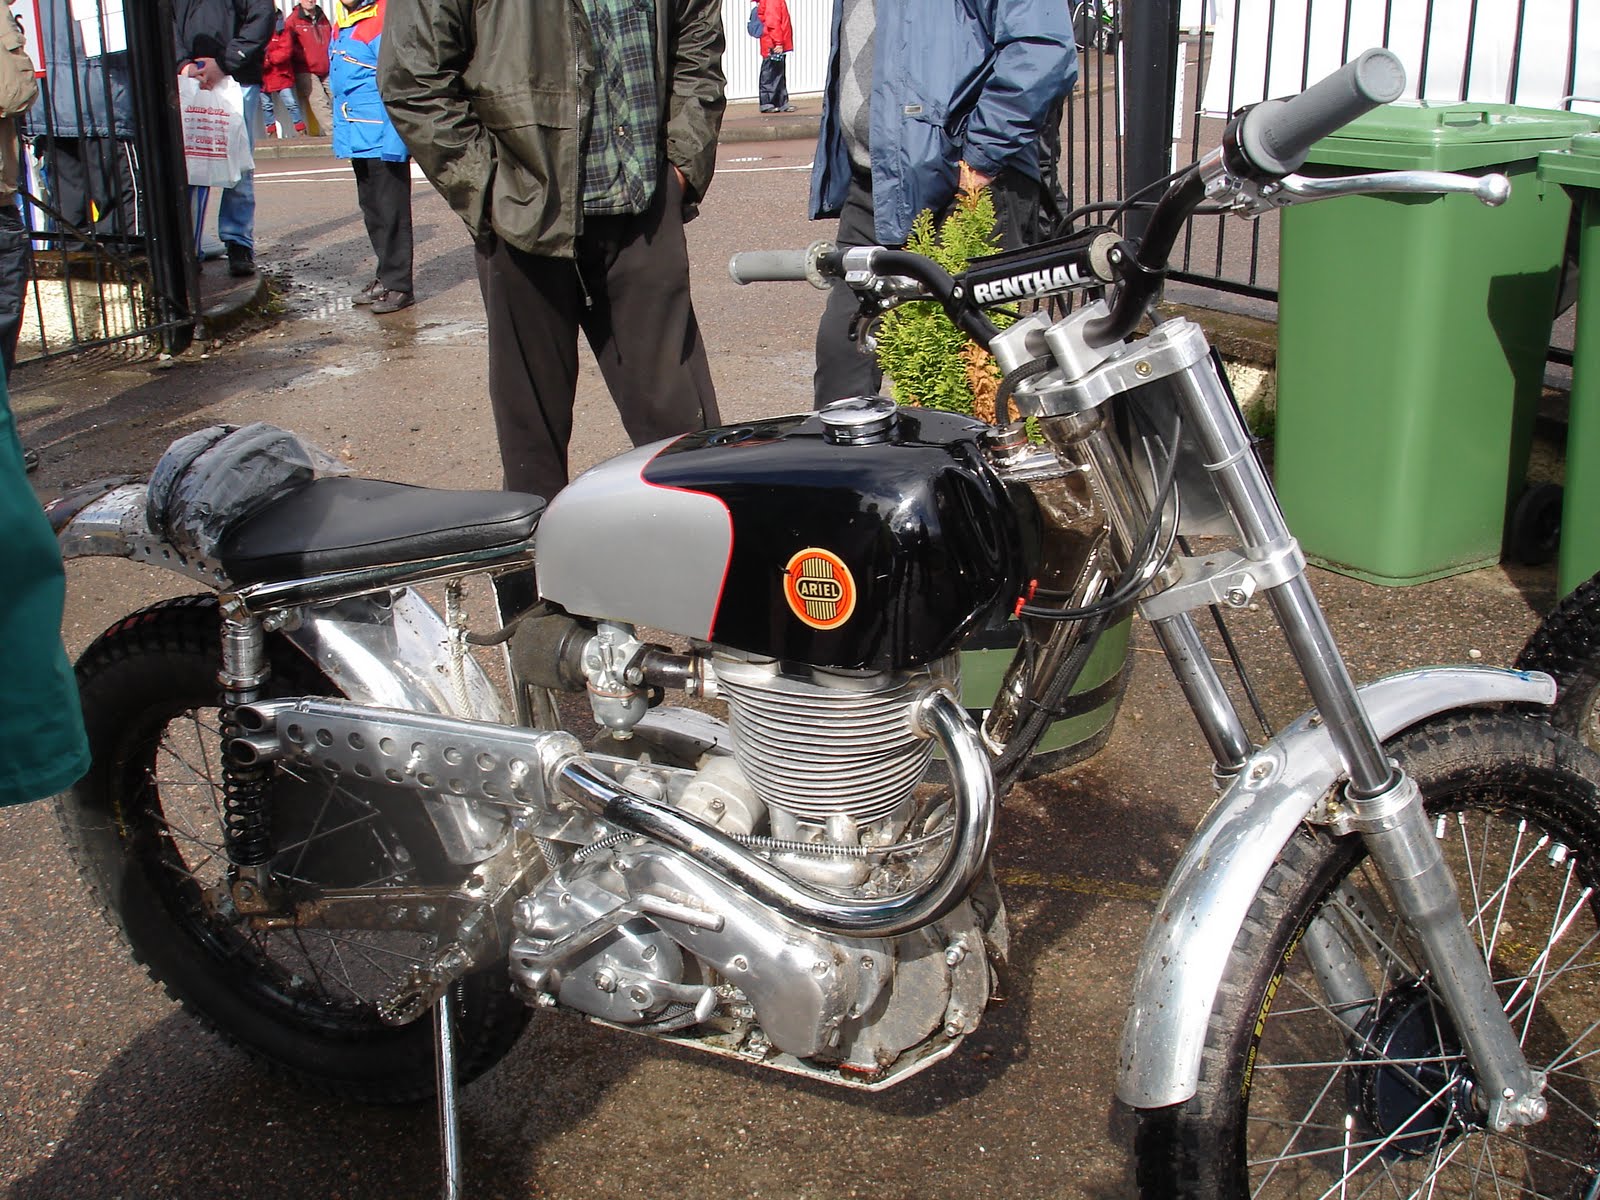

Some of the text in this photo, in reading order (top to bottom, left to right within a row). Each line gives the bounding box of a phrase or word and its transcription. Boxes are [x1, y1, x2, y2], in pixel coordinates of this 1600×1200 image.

[973, 263, 1081, 304] RENTHAL
[801, 582, 838, 597] ARIEL
[1254, 974, 1282, 1037] EXCEL
